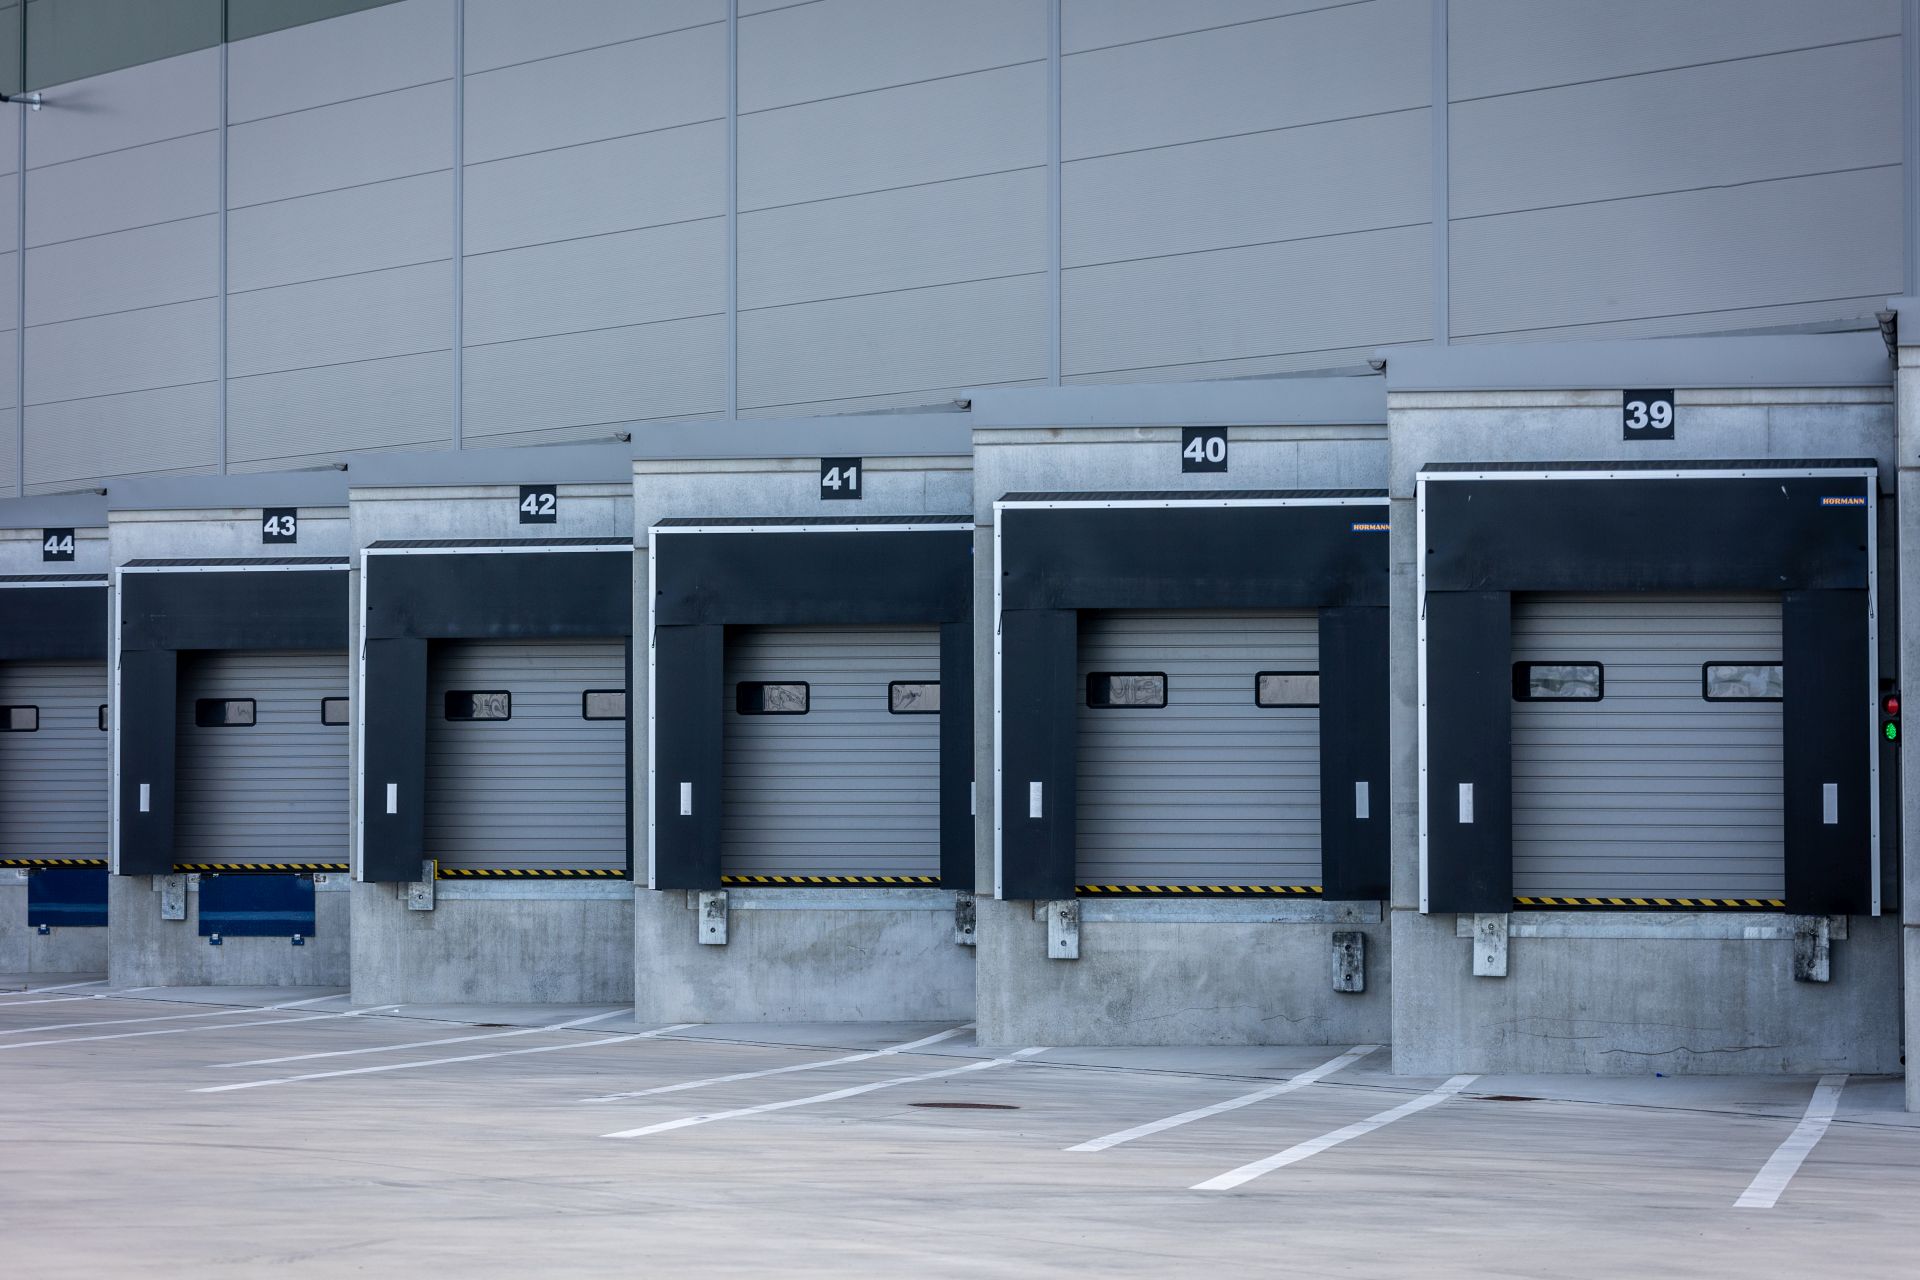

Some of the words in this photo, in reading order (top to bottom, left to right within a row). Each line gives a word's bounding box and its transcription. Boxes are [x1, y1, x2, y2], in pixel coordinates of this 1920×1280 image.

[1625, 400, 1673, 430] 39
[1184, 437, 1226, 463] 40
[822, 466, 857, 490] 41
[520, 493, 555, 515] 42
[264, 515, 296, 536] 43
[44, 535, 74, 554] 44
